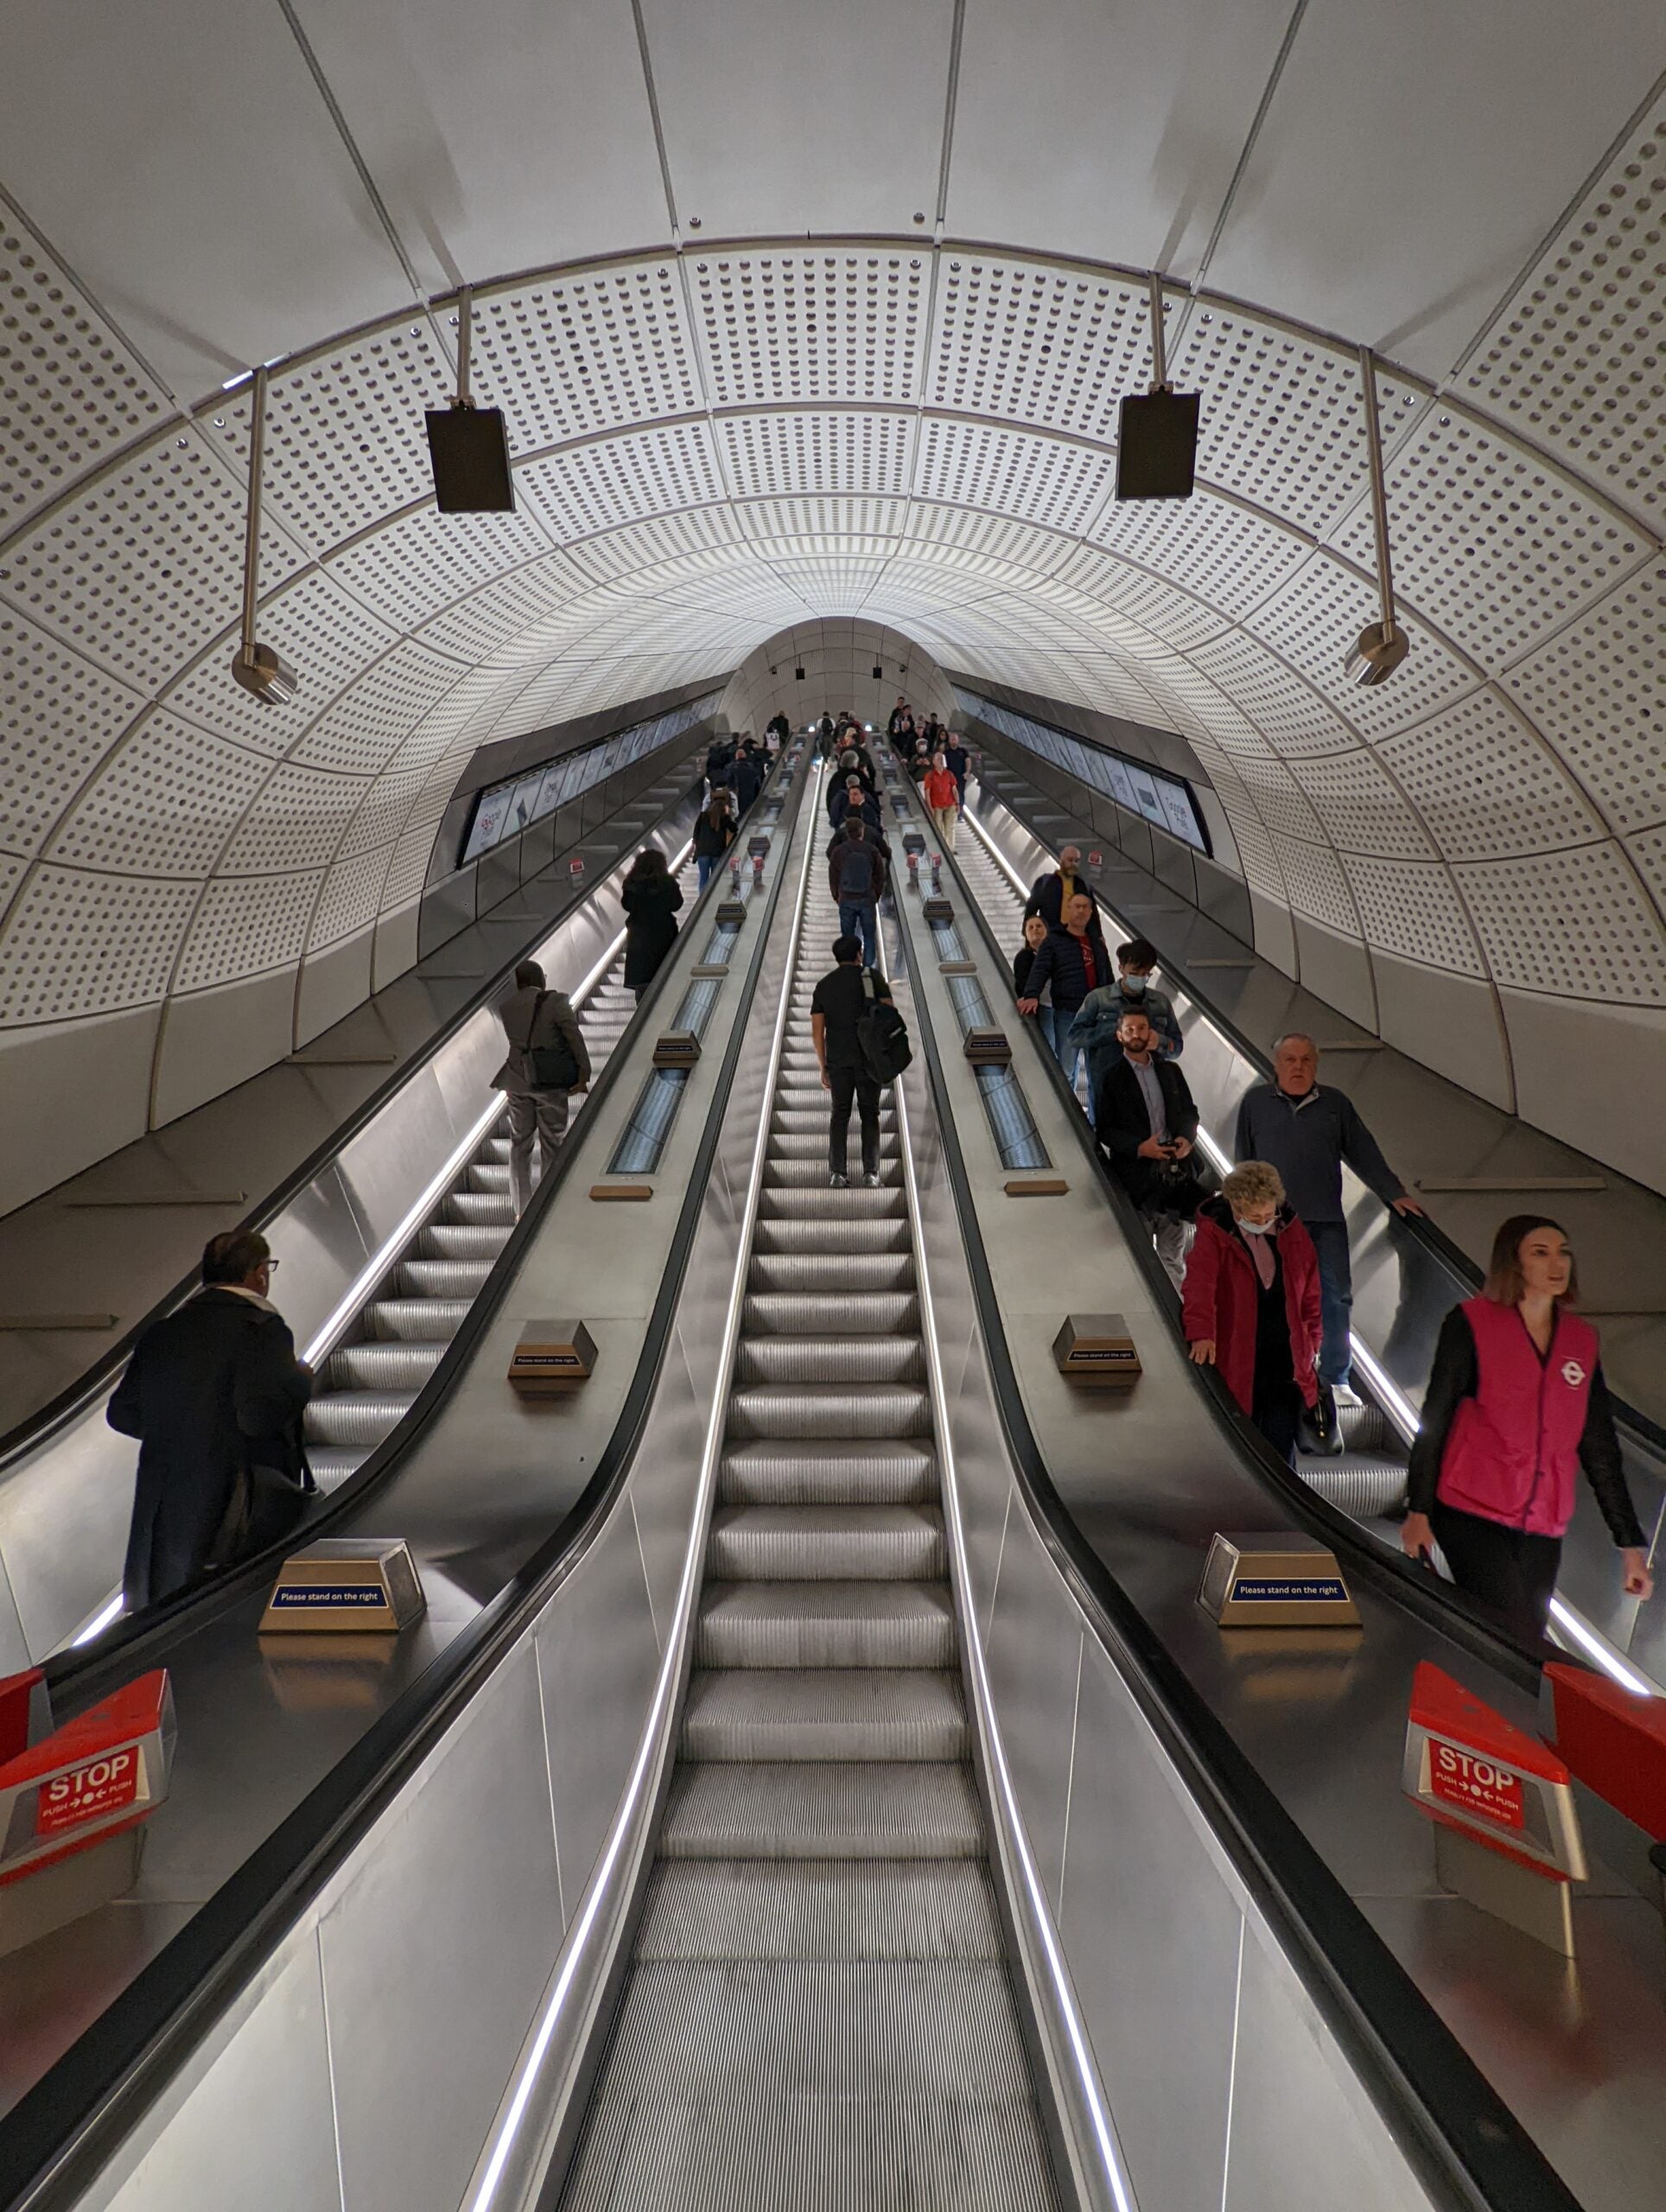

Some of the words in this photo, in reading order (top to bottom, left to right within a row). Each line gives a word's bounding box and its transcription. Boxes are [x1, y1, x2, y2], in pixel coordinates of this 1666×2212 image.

[281, 1592, 307, 1601] Please
[359, 1592, 378, 1601] right
[1319, 1586, 1339, 1595] right
[49, 1754, 130, 1802] STOP
[1439, 1746, 1514, 1791] STOP
[42, 1802, 67, 1817] PUSH
[109, 1780, 131, 1793] PUSH
[1435, 1771, 1458, 1787] PUSH
[1495, 1796, 1519, 1811] PUSH
